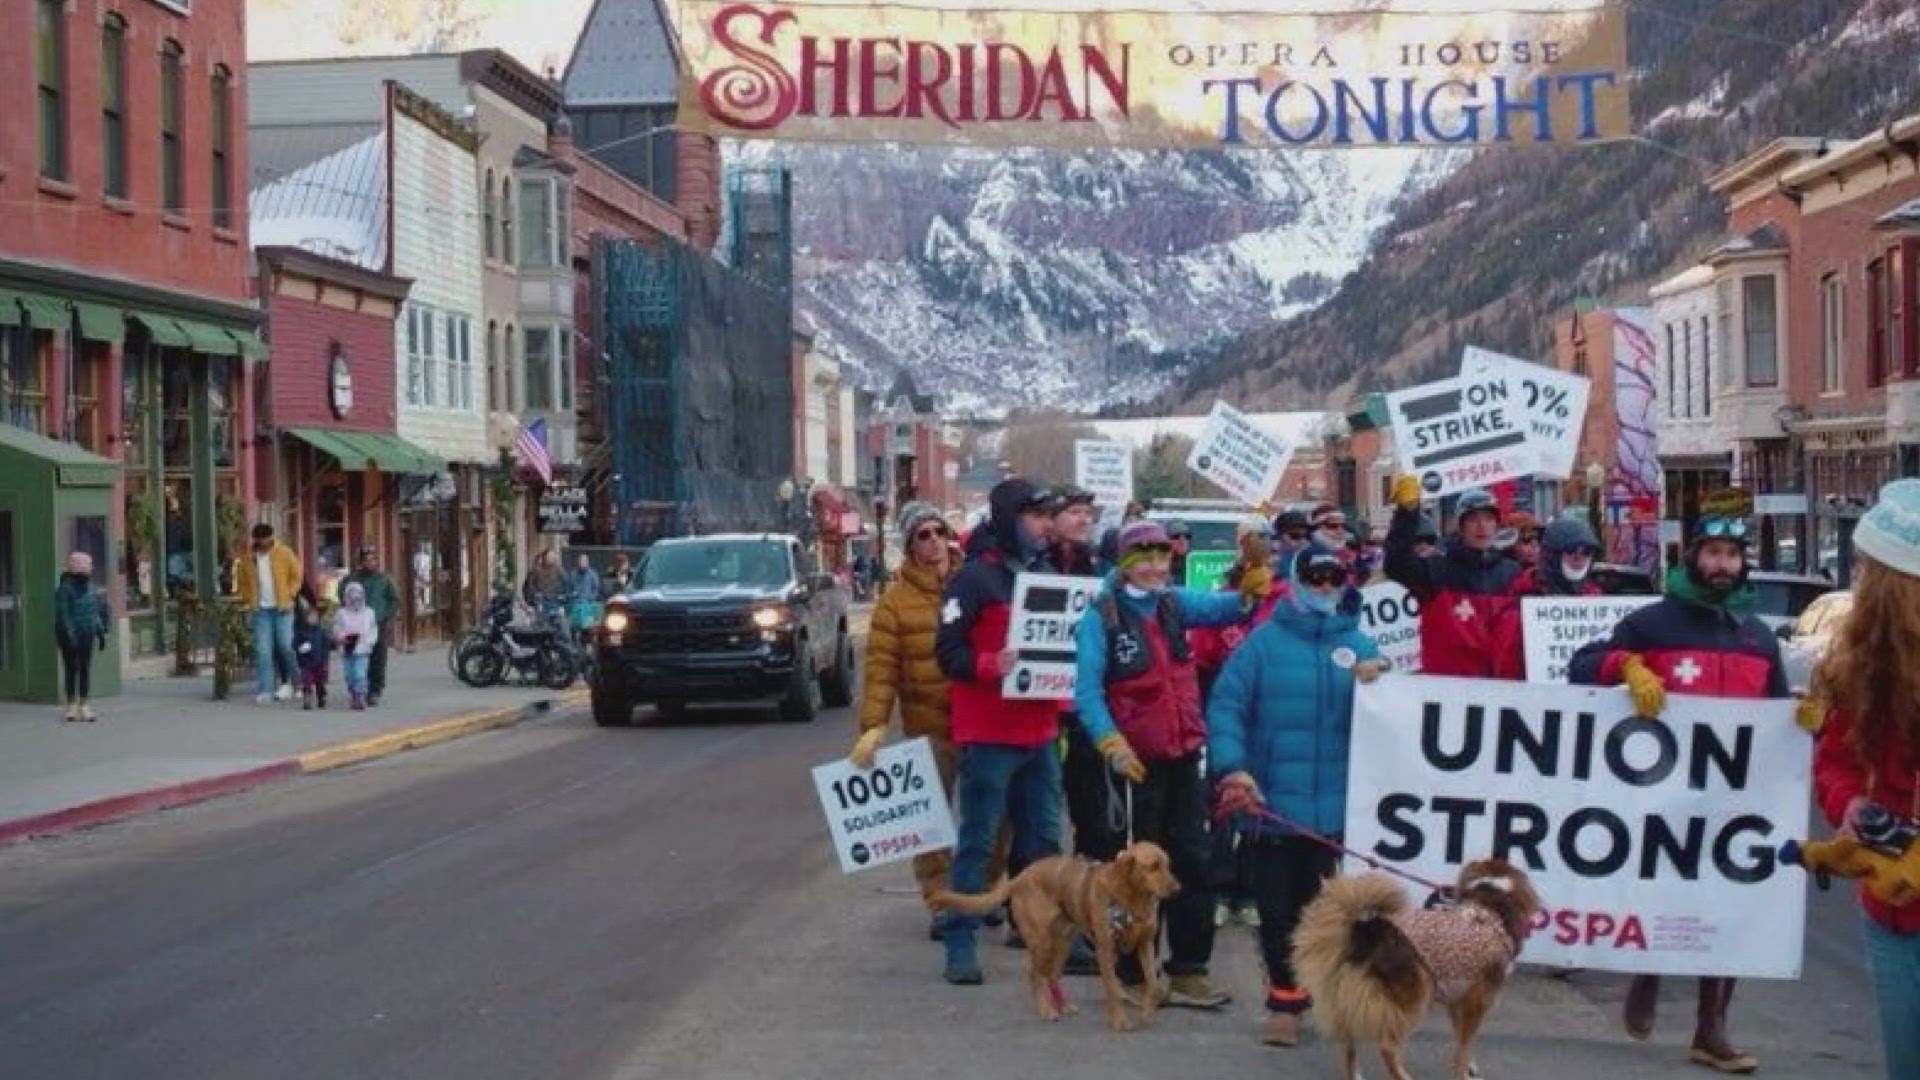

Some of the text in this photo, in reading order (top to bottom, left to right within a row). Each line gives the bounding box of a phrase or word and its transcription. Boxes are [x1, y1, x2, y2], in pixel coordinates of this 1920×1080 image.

[699, 4, 1132, 131] SHERIDAN
[1168, 41, 1562, 66] OPERA HOUSE
[1202, 71, 1615, 144] TONIGHT
[1468, 378, 1509, 406] ON
[1413, 408, 1514, 448] STRIKE.
[1536, 604, 1588, 621] HONK
[1594, 604, 1609, 620] IF
[1420, 702, 1753, 791] UNION
[831, 758, 925, 809] 100%
[1373, 793, 1777, 884] STRONG
